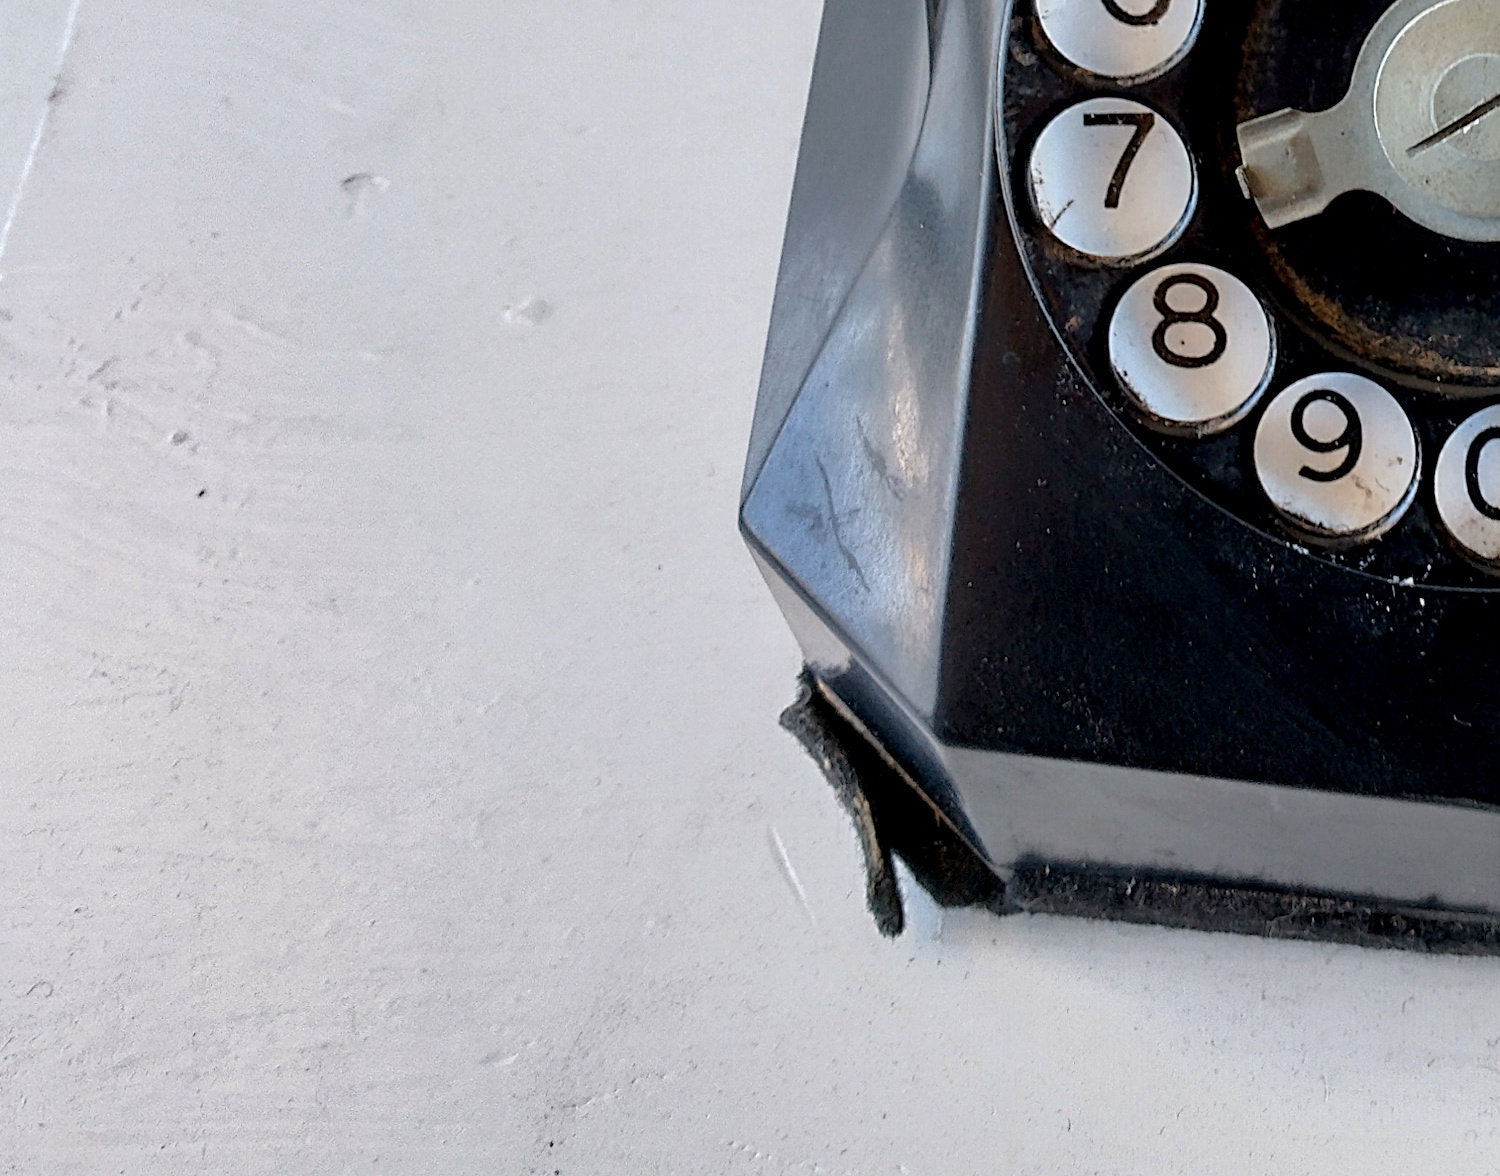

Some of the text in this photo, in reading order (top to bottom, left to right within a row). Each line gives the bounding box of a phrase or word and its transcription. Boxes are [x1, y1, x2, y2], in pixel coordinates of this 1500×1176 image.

[1083, 112, 1156, 210] 7
[1151, 273, 1228, 369] 8
[1290, 388, 1363, 483] 9
